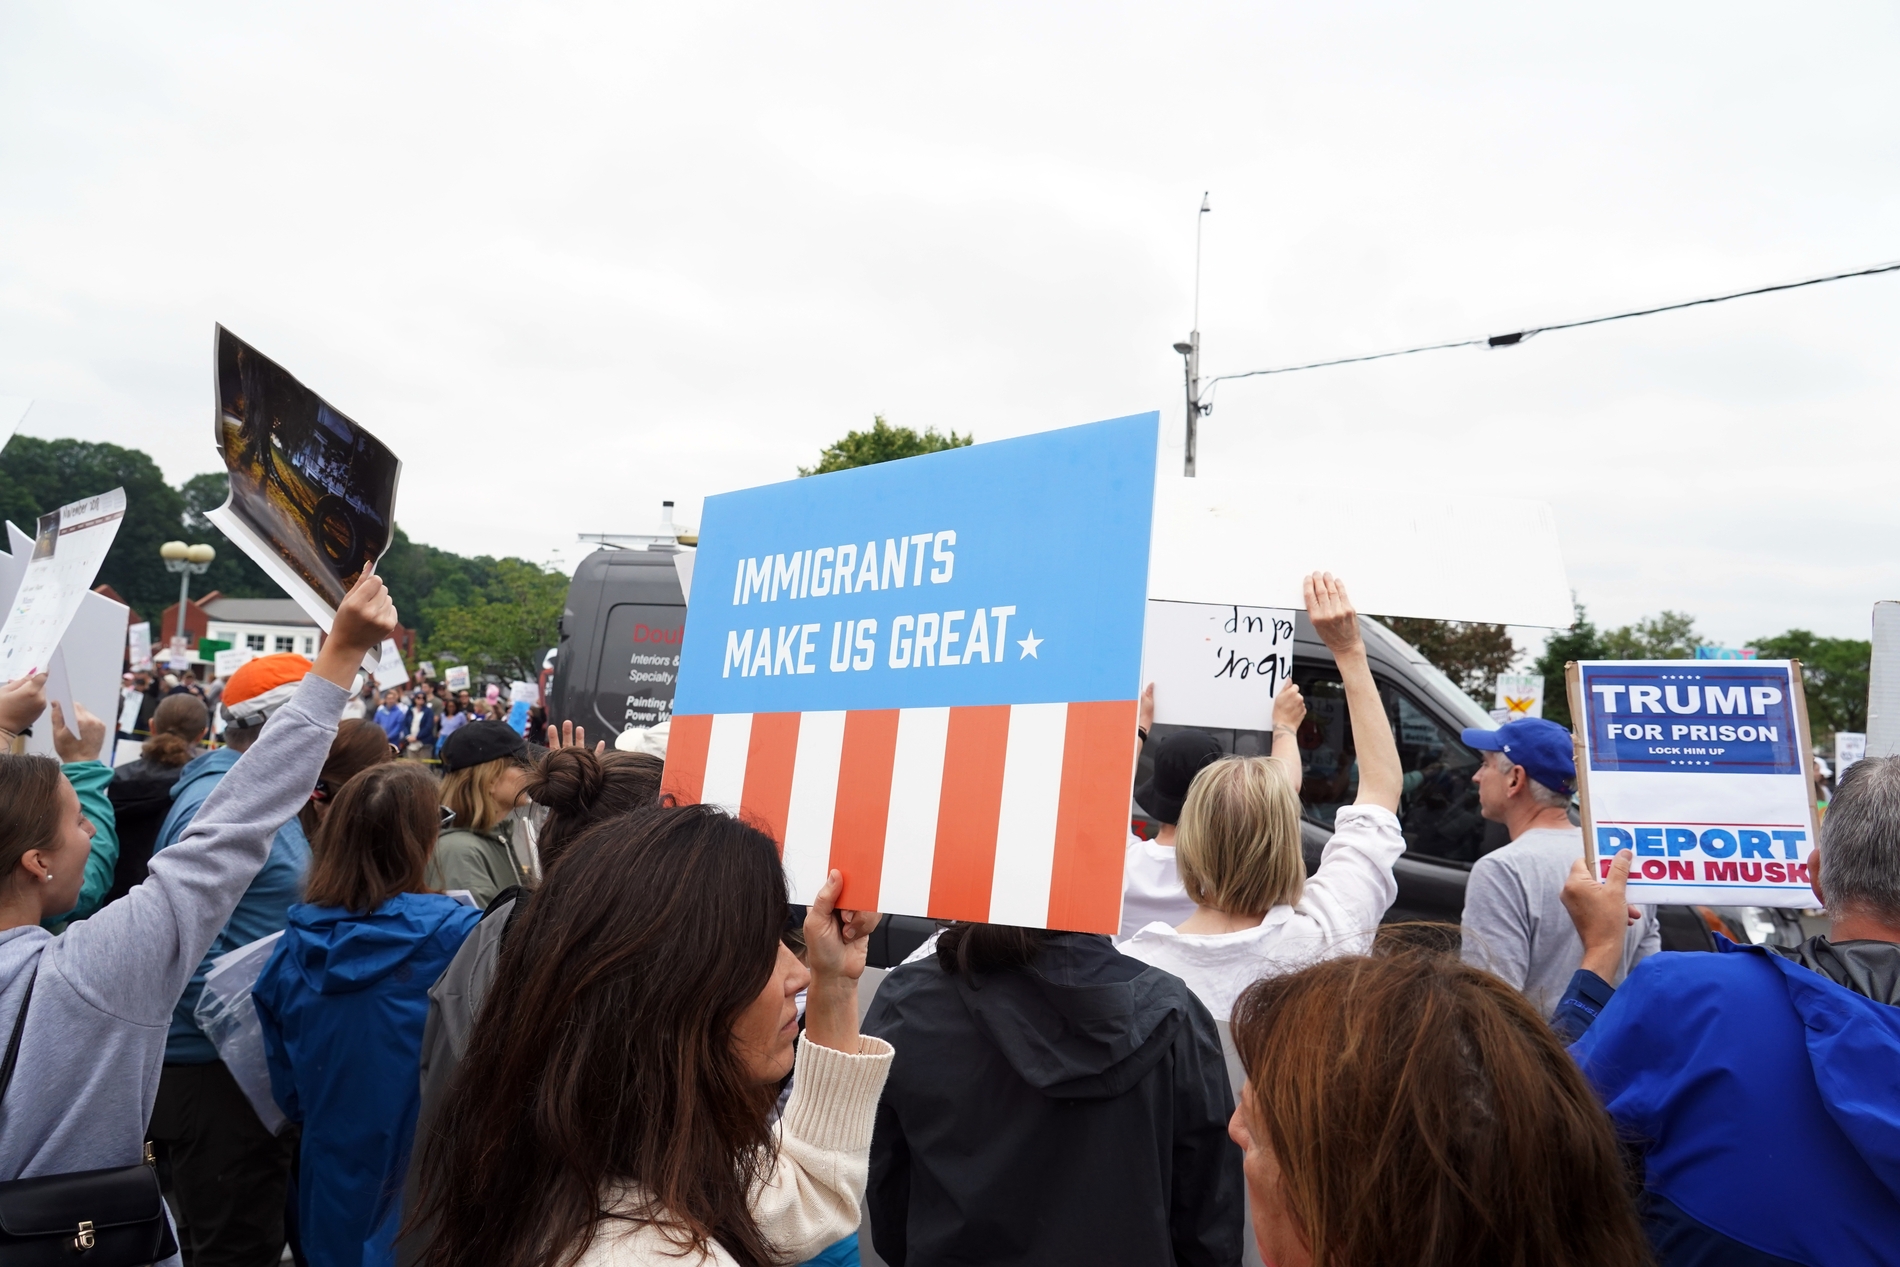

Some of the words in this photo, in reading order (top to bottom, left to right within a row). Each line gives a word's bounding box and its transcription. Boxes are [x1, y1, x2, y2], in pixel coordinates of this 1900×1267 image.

[732, 530, 956, 606] IMMIGRANTS
[1224, 605, 1263, 633] up
[722, 623, 821, 678] MAKE
[829, 618, 877, 673] US
[888, 605, 1016, 669] GREAT
[630, 653, 670, 667] Interiors
[672, 655, 680, 667] &
[629, 669, 674, 685] Specialty
[626, 696, 667, 711] Painting
[1592, 685, 1782, 715] TRUMP
[625, 709, 657, 721] Power
[1607, 724, 1664, 740] FOR
[1671, 725, 1779, 742] PRISON
[1649, 747, 1680, 755] LOCK
[1683, 747, 1706, 755] HIM
[1597, 828, 1807, 859] DEPORT
[1704, 861, 1811, 883] MUSK
